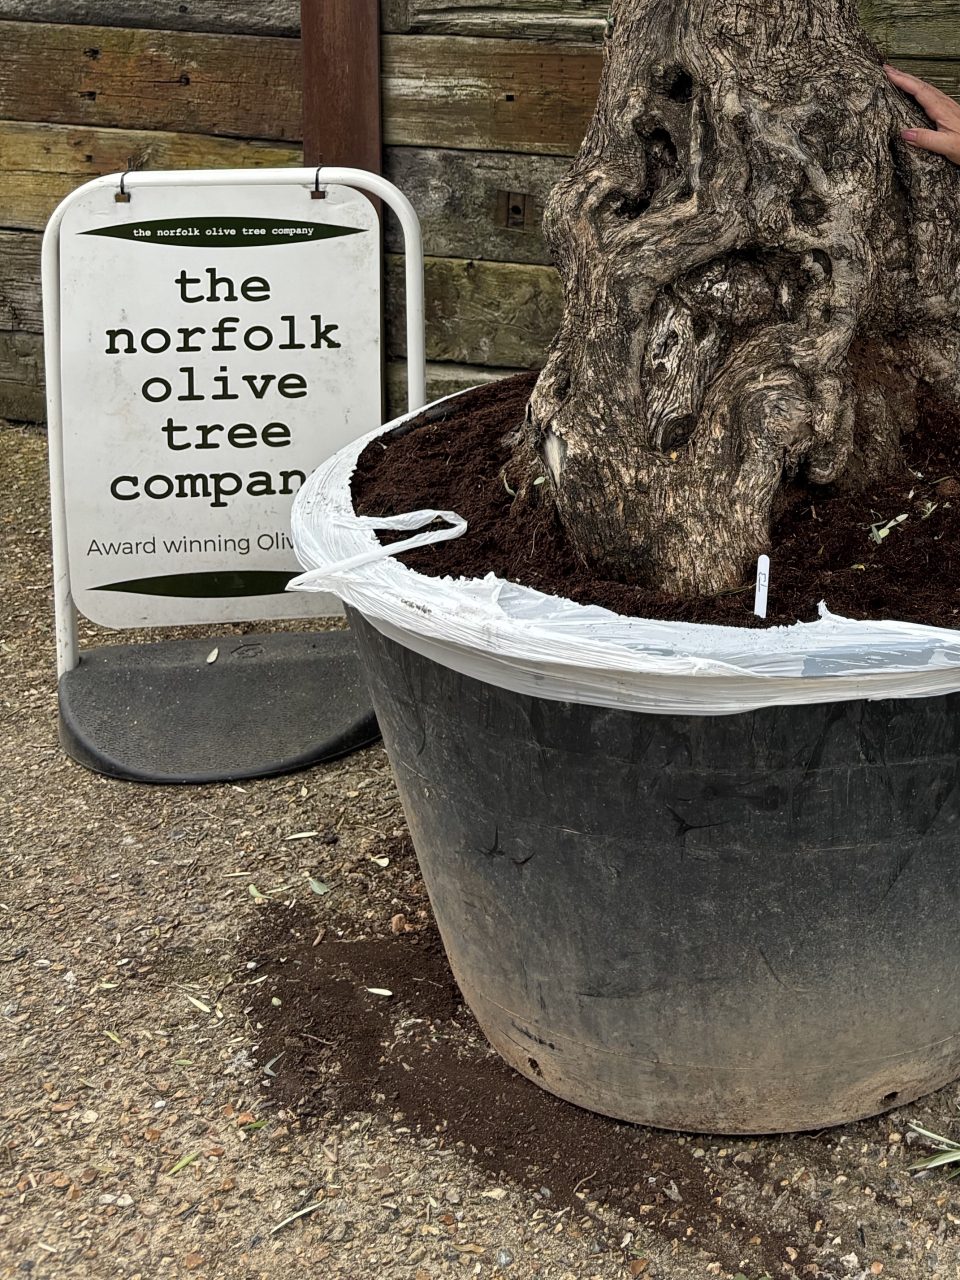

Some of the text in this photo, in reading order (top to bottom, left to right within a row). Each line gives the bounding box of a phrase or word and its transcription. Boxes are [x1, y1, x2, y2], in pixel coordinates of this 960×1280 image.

[132, 226, 314, 237] the norfolk olive tree company
[174, 267, 272, 304] the
[105, 314, 342, 355] norfolk
[141, 365, 308, 403] olive
[161, 417, 291, 451] tree
[110, 469, 316, 507] compan
[86, 536, 156, 556] Award
[163, 534, 250, 556] winning
